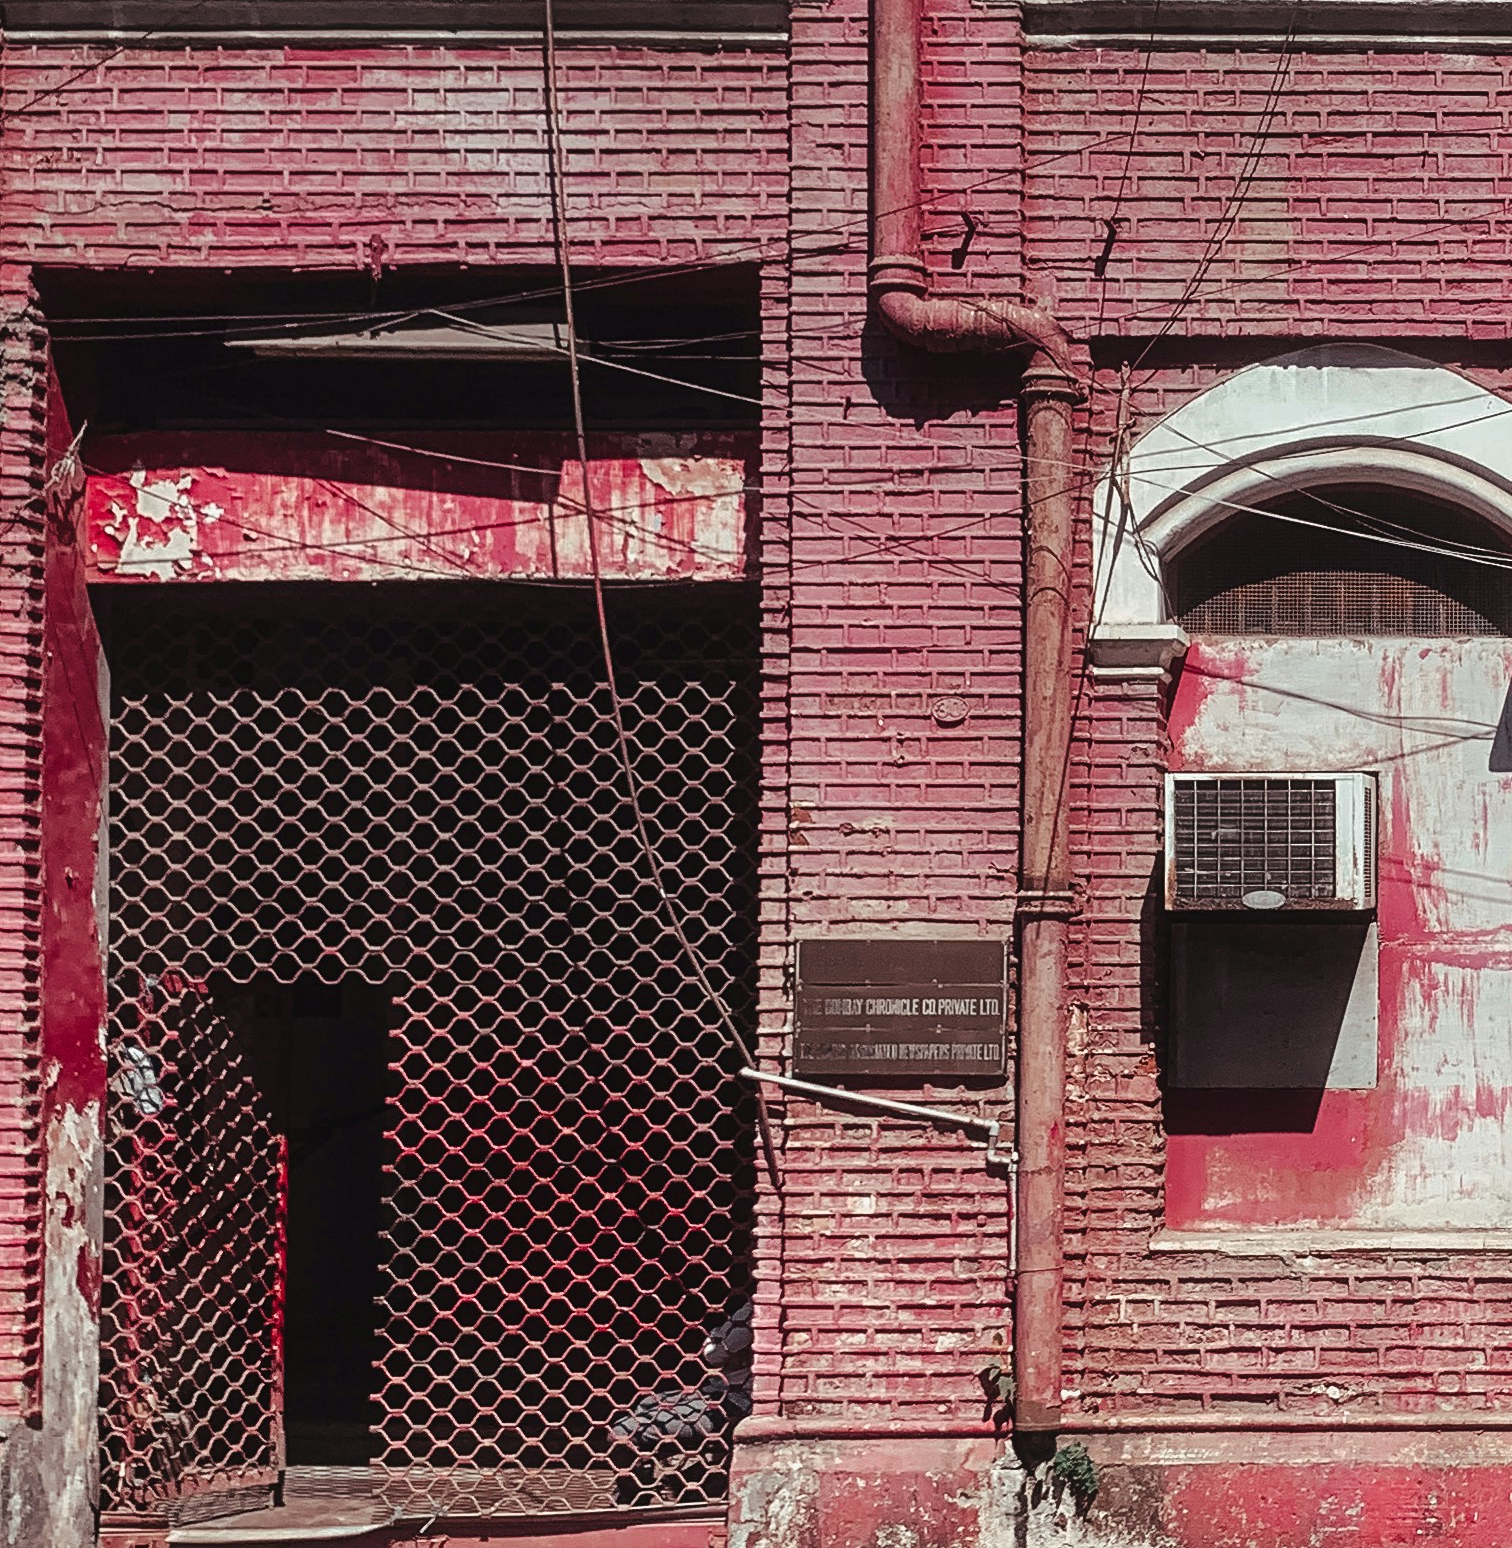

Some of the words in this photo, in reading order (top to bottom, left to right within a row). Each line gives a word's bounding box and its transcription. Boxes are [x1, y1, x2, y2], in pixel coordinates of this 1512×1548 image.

[865, 998, 919, 1015] CHRONICLE
[938, 998, 977, 1015] PRIVATE
[979, 998, 1000, 1015] LTD.
